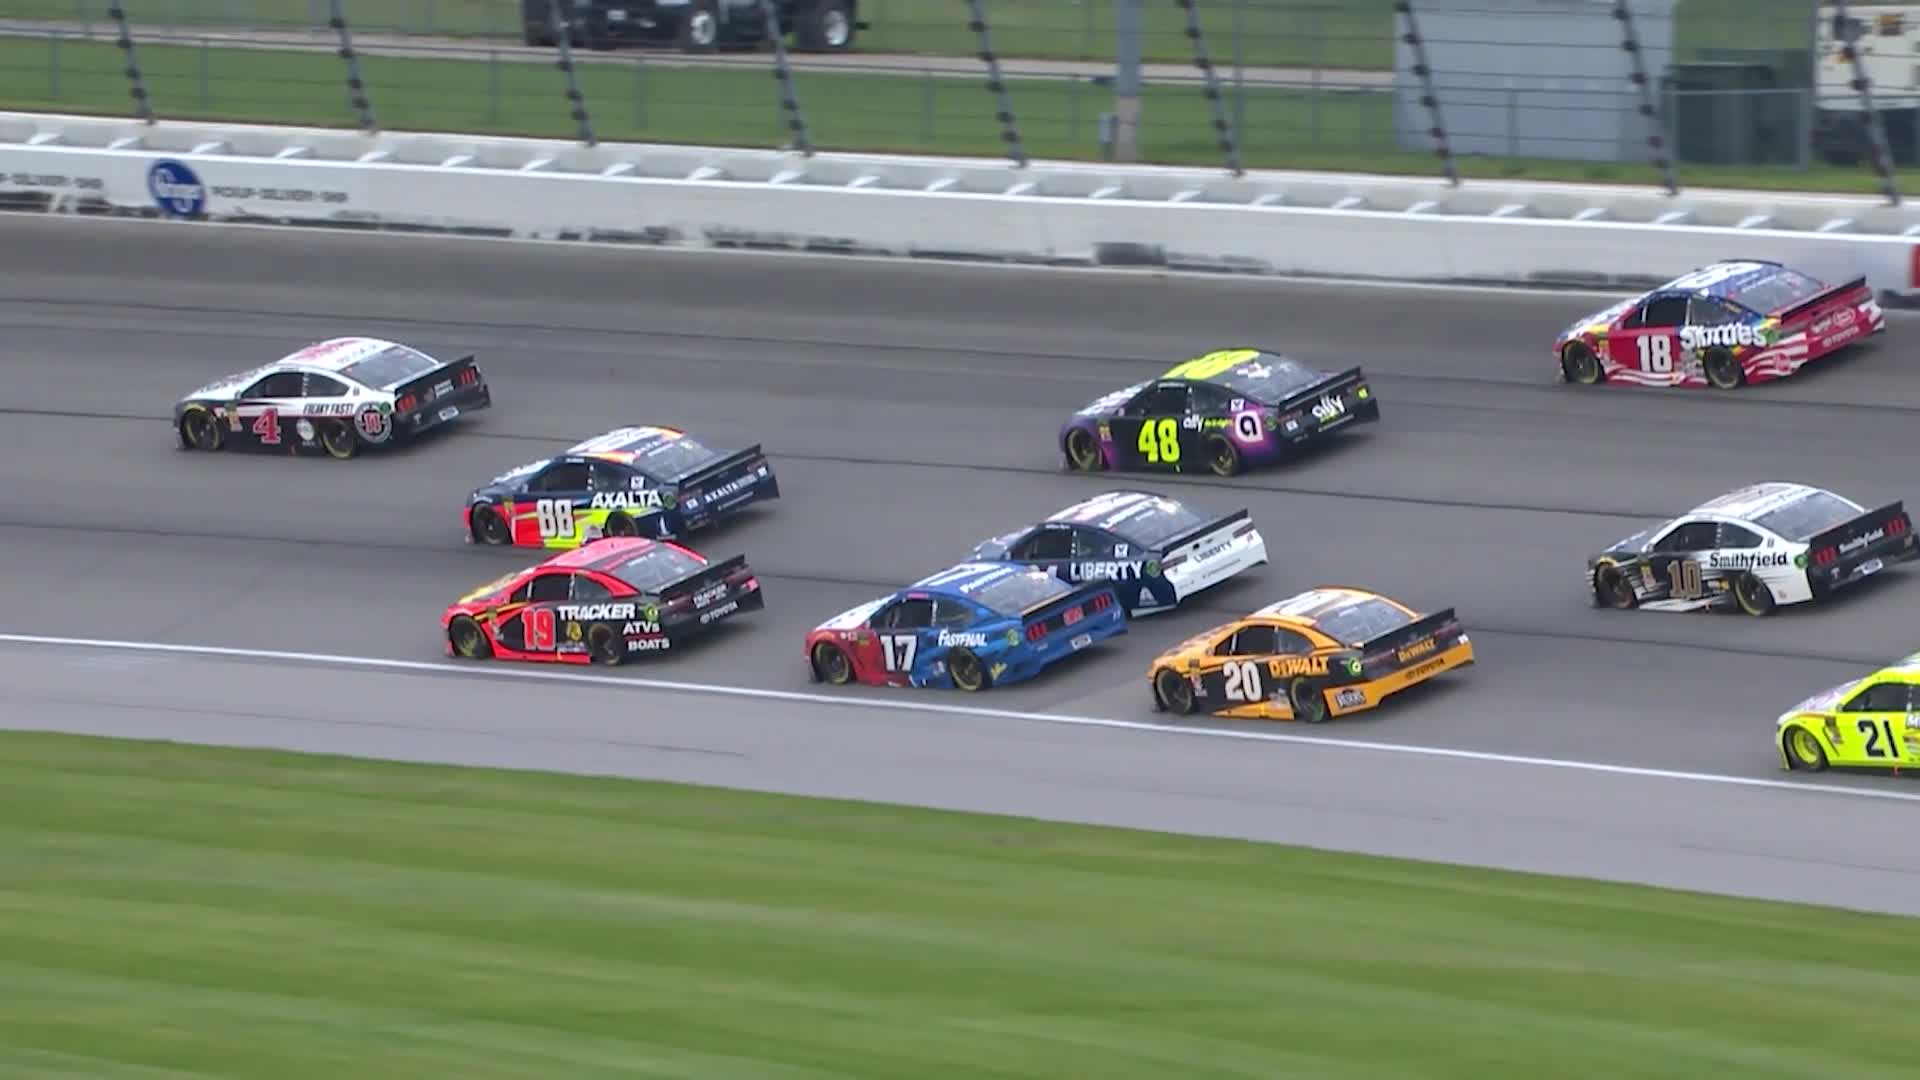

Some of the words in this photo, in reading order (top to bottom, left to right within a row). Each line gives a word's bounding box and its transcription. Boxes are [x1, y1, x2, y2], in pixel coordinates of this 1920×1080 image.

[1636, 335, 1673, 373] 18
[253, 408, 282, 444] 4
[1137, 418, 1181, 463] 48
[590, 489, 663, 509] AXALTA
[536, 499, 575, 538] 88
[1070, 560, 1143, 581] LIBERTY
[1709, 552, 1788, 568] Smithfield
[1667, 560, 1702, 599] 10
[521, 608, 556, 650] 19
[557, 603, 636, 620] TRACKER
[628, 638, 670, 651] BOATS
[878, 634, 919, 672] 17
[1222, 659, 1263, 701] 20
[1857, 720, 1899, 758] 21
